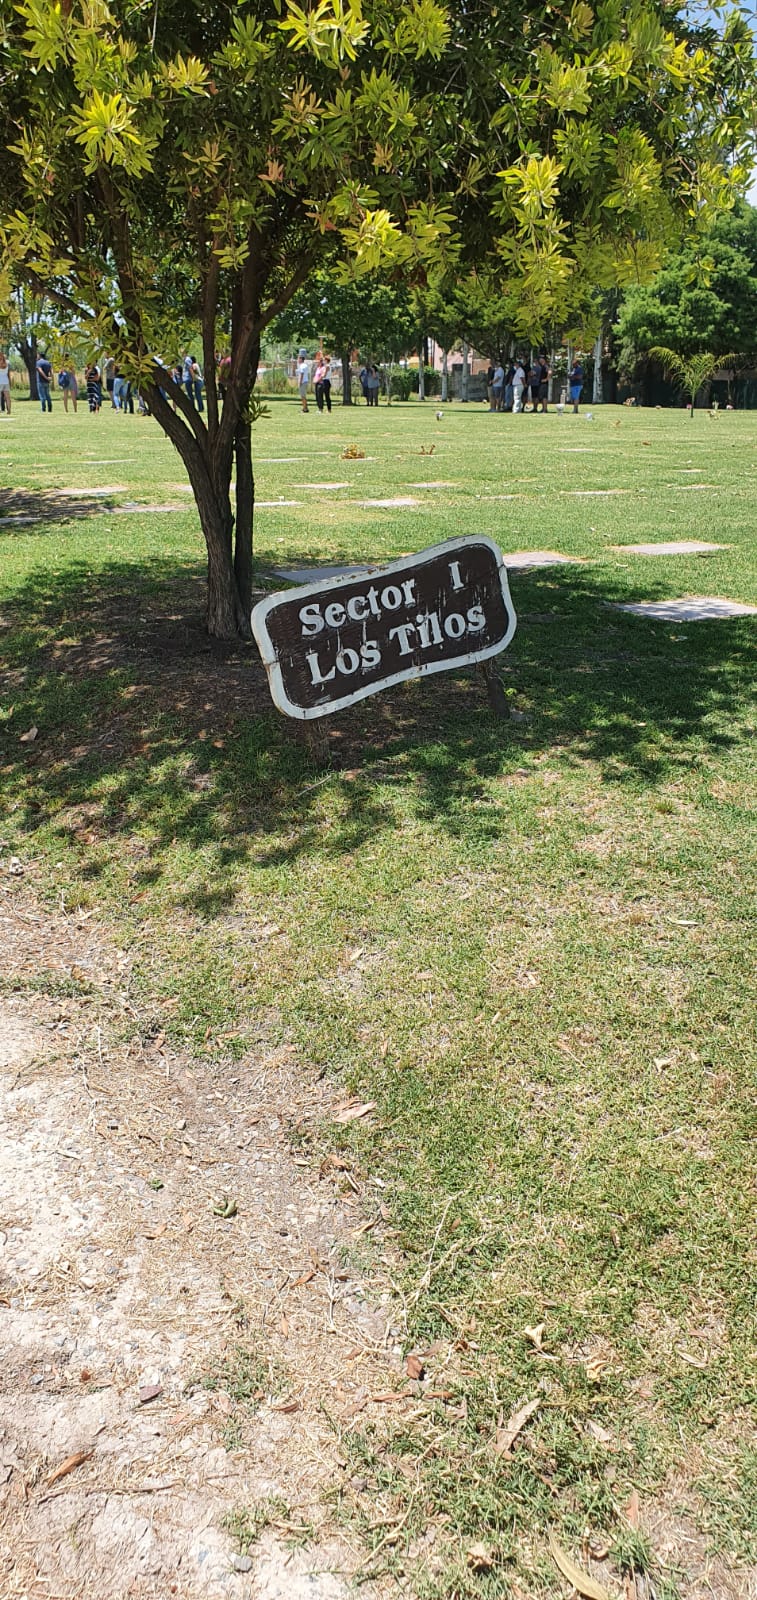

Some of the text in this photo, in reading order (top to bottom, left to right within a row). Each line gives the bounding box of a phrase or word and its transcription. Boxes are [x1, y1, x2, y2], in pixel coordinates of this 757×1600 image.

[299, 561, 465, 636] Sector I
[305, 605, 486, 685] Los Tilos
